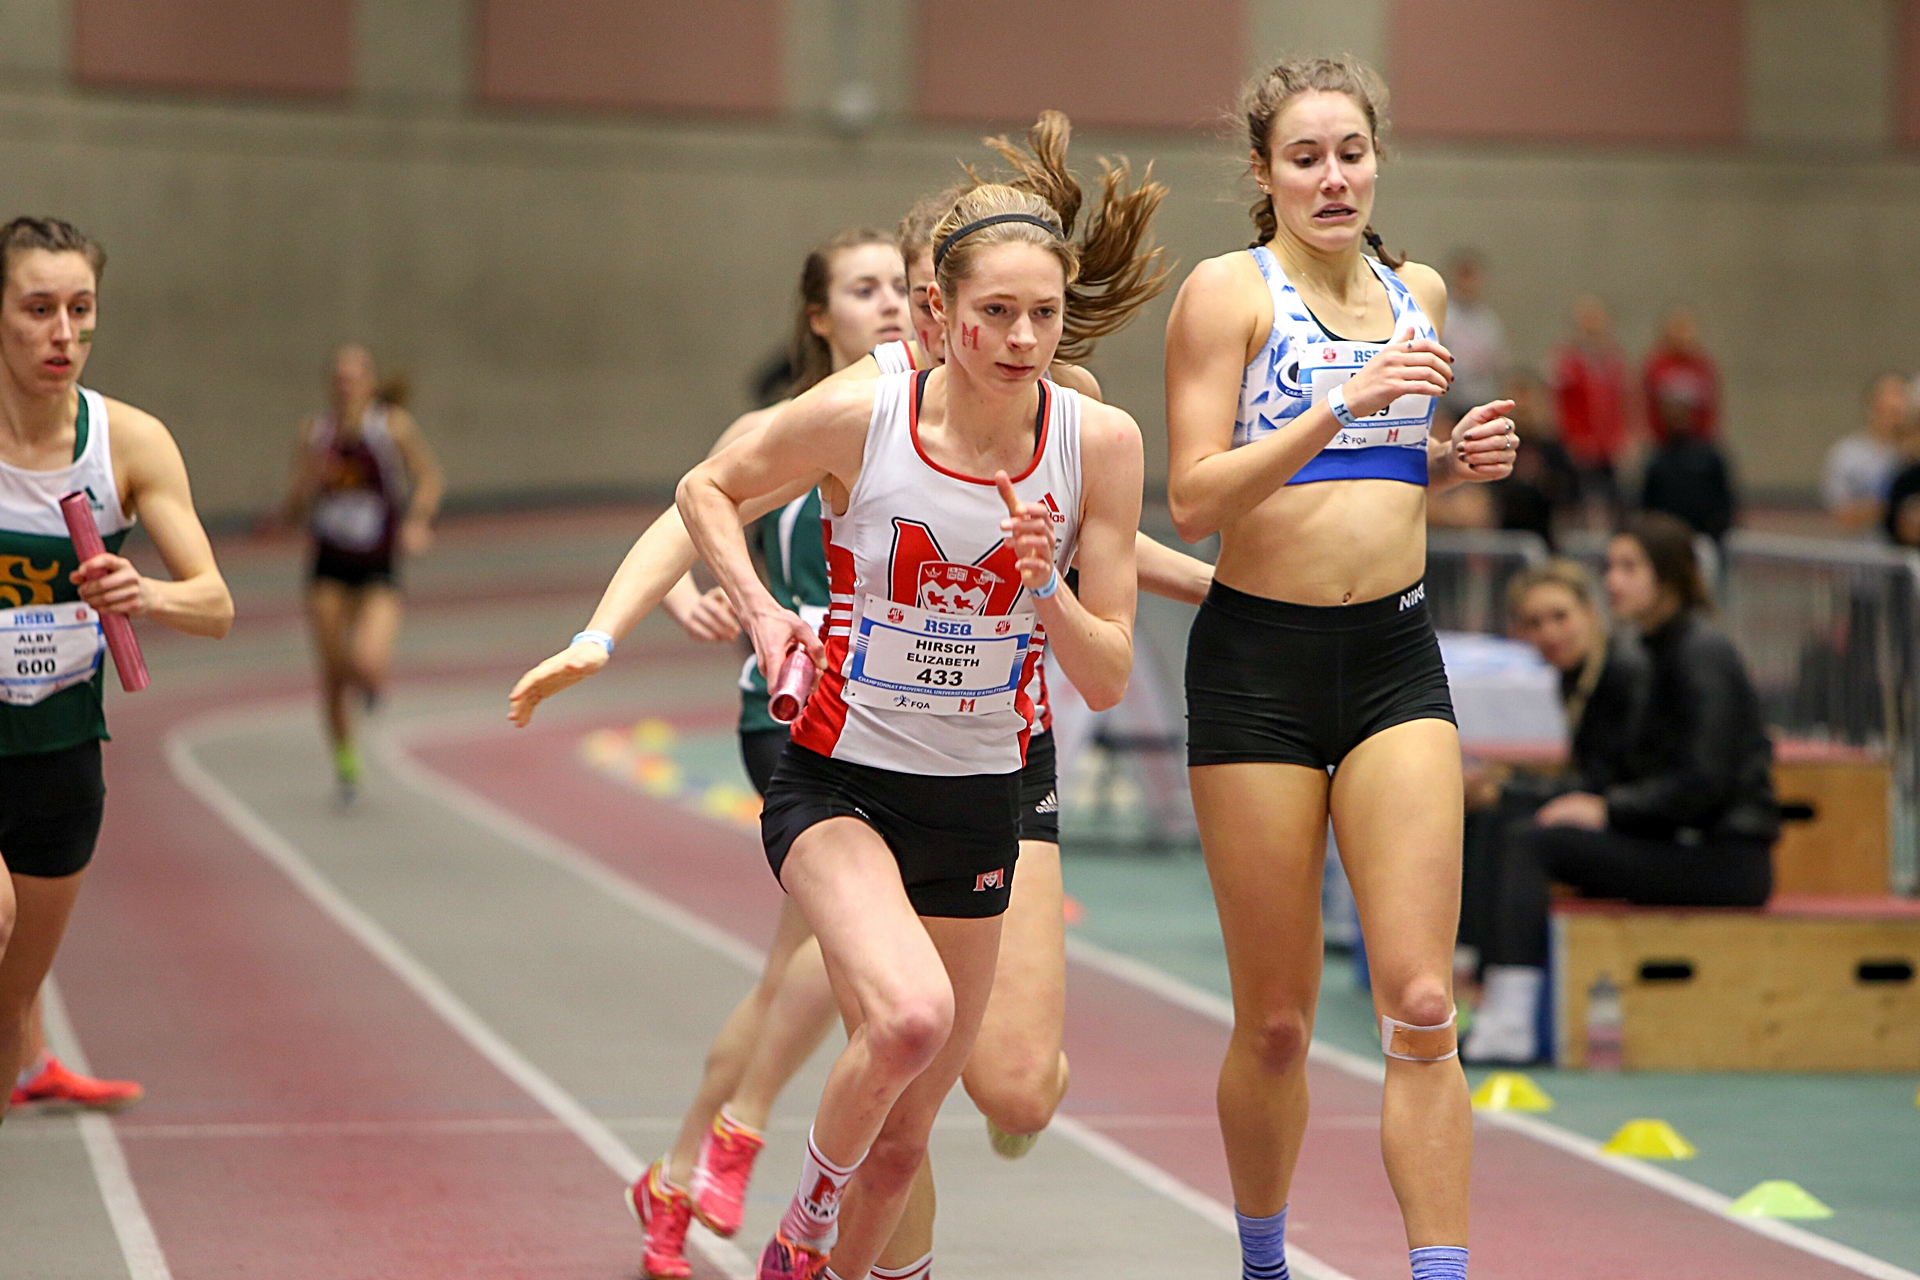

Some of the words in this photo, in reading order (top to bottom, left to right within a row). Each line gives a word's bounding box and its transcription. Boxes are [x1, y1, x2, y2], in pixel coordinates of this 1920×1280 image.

[1351, 436, 1367, 445] FQA
[14, 611, 55, 625] RSEQ
[923, 619, 973, 636] RSEQ
[18, 633, 53, 643] ALBY
[915, 639, 976, 655] HIRSCH
[17, 658, 56, 675] 600
[906, 653, 981, 668] ELIZABETH
[916, 668, 964, 687] 433
[858, 676, 898, 690] CHAMPIONNAT
[898, 685, 934, 695] PROVINCIAL
[933, 689, 977, 697] UNIVERSITAIRE
[910, 701, 931, 710] FQA
